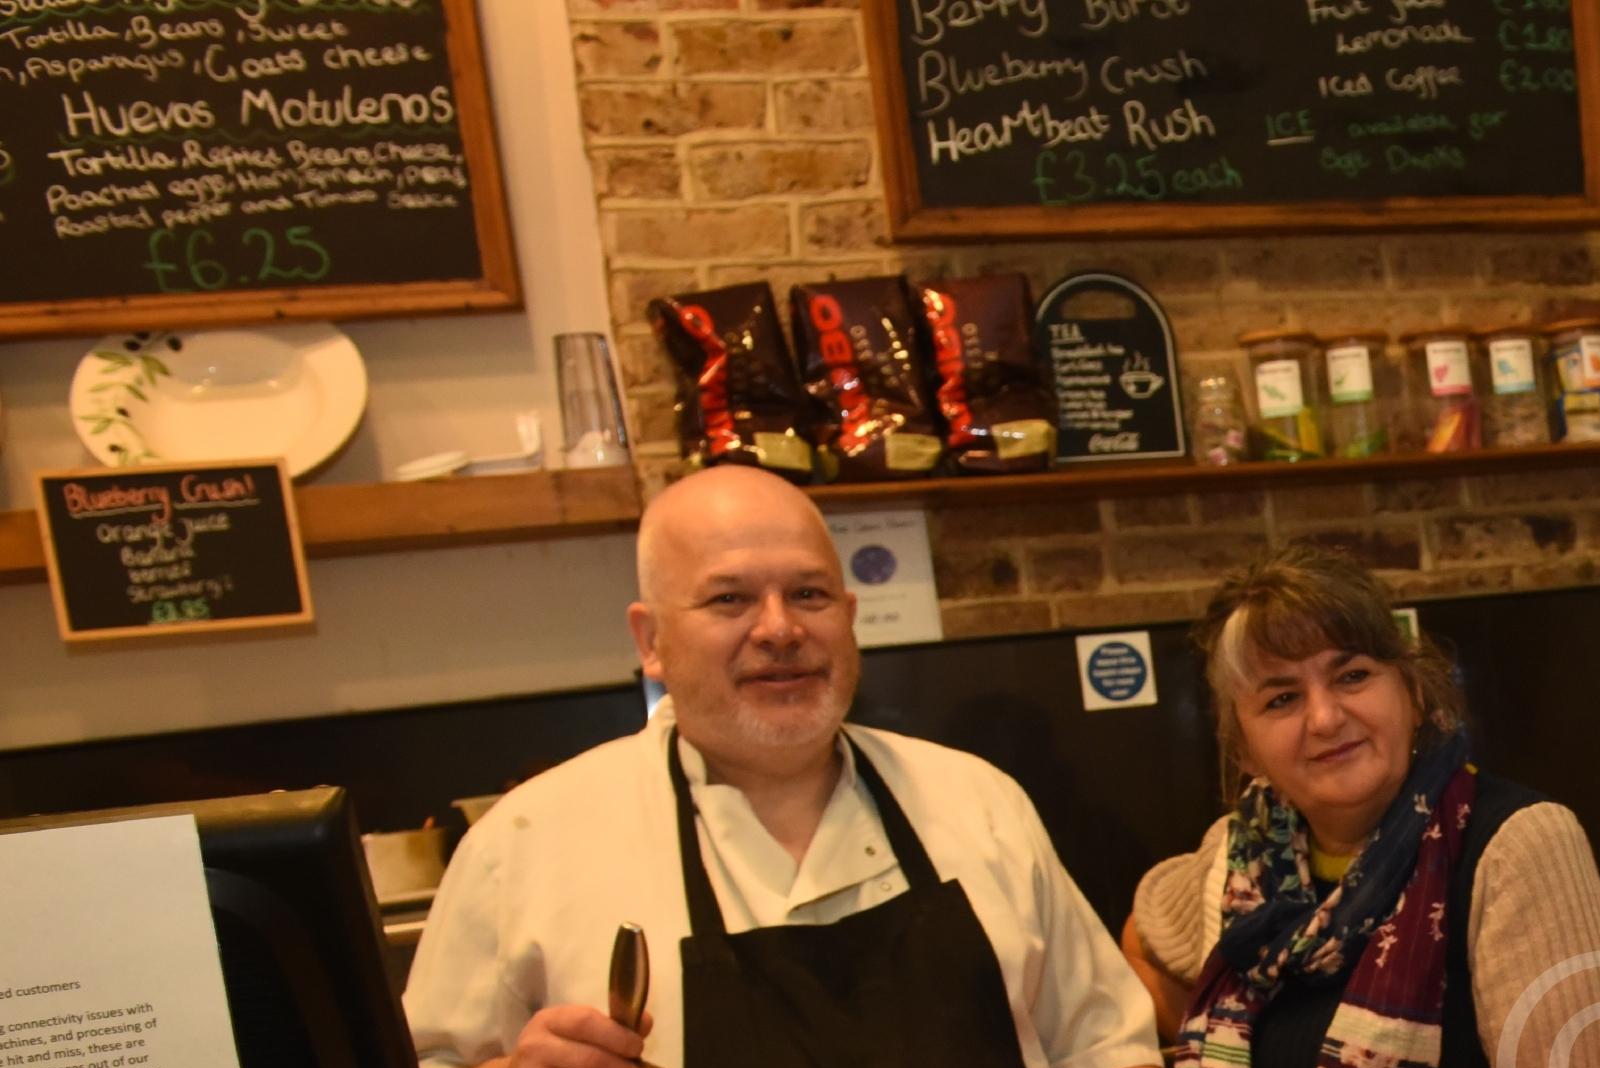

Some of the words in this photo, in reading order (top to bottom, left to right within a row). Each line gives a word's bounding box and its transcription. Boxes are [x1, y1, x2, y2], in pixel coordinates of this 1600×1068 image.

[918, 51, 1090, 117] Blueberry
[1101, 49, 1208, 95] Crush
[62, 90, 216, 138] Huevos
[241, 85, 454, 130] Motulenos
[928, 99, 1112, 166] Heartbeat
[1123, 98, 1217, 151] Rush
[1032, 149, 1165, 207] £3.25
[144, 226, 331, 293] £6.25
[16, 980, 81, 998] customers
[8, 1012, 84, 1033] connectivity
[86, 1007, 124, 1022] issues
[126, 1002, 154, 1016] with
[50, 1029, 74, 1044] and
[76, 1022, 143, 1042] processing
[144, 1017, 158, 1030] of
[7, 1054, 25, 1067] hit
[27, 1050, 52, 1064] and
[54, 1047, 86, 1060] miss,
[88, 1042, 123, 1055] these
[125, 1038, 146, 1049] are
[112, 1056, 126, 1068] of
[127, 1054, 149, 1066] our
